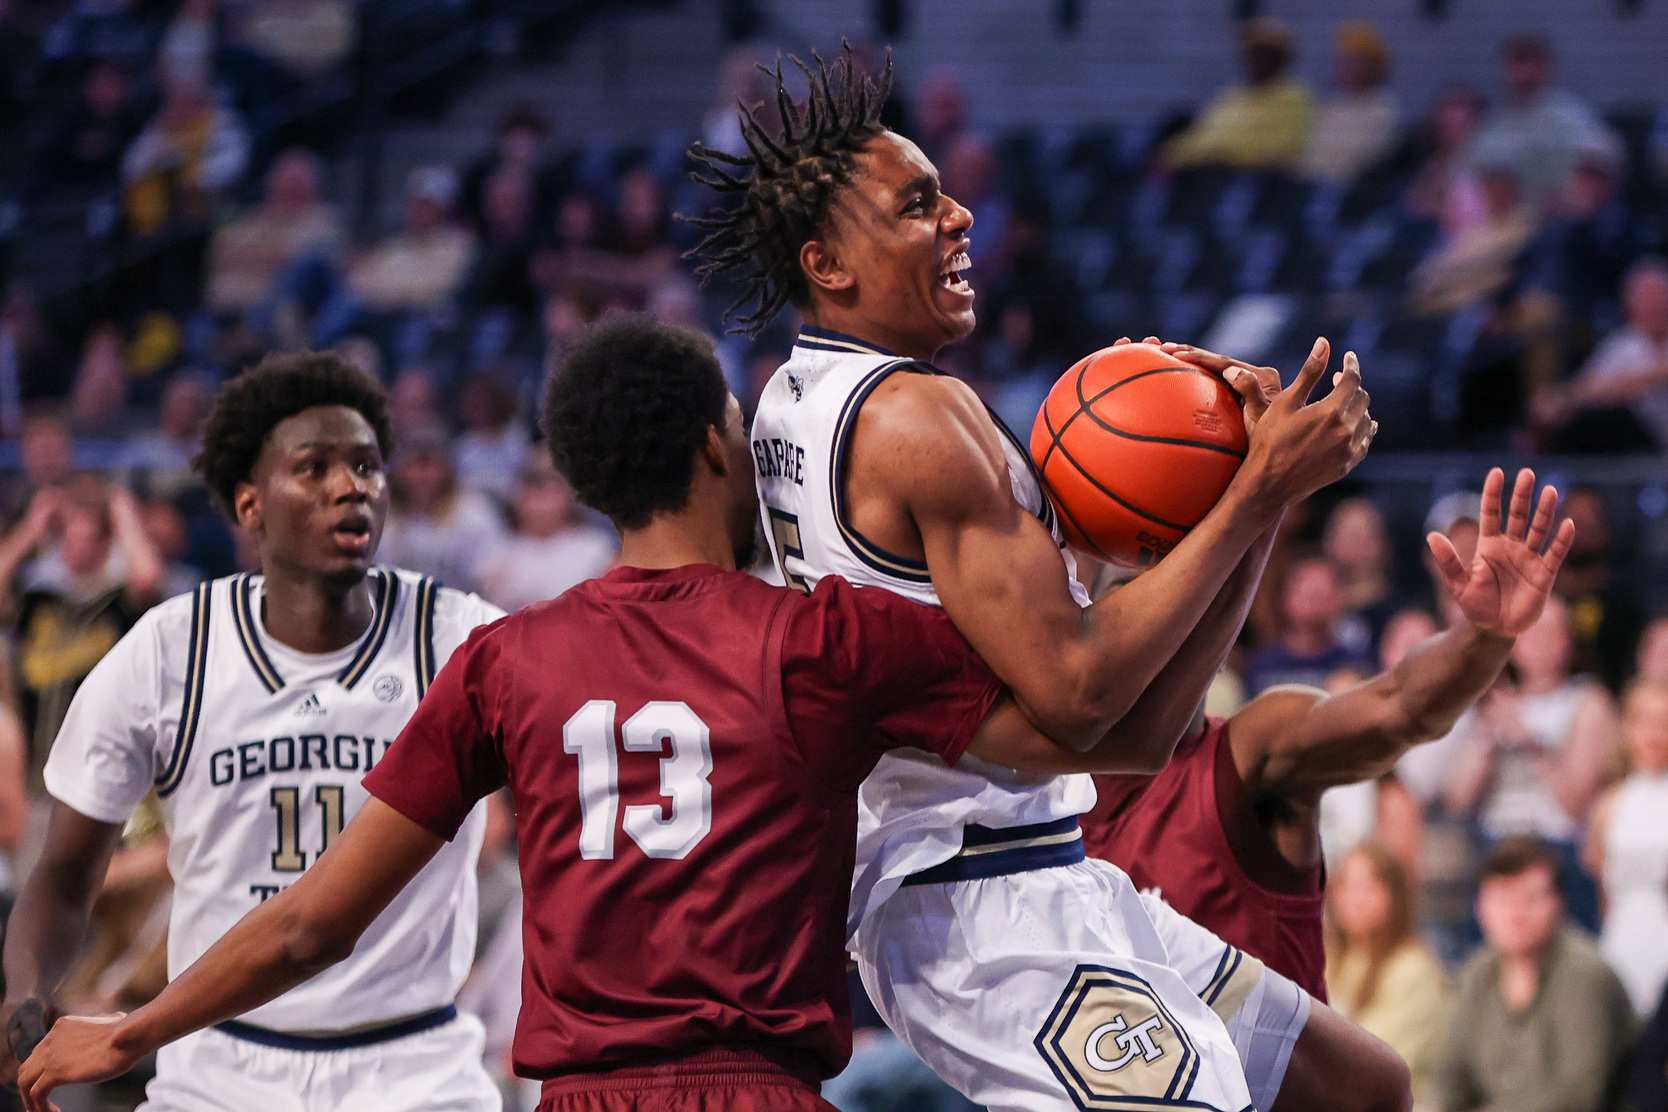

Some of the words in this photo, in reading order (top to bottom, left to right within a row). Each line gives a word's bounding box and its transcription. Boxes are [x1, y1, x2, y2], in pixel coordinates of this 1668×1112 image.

[210, 734, 393, 787] GEORGI
[562, 699, 713, 861] 13
[270, 785, 344, 872] 11
[1084, 1013, 1164, 1072] GT
